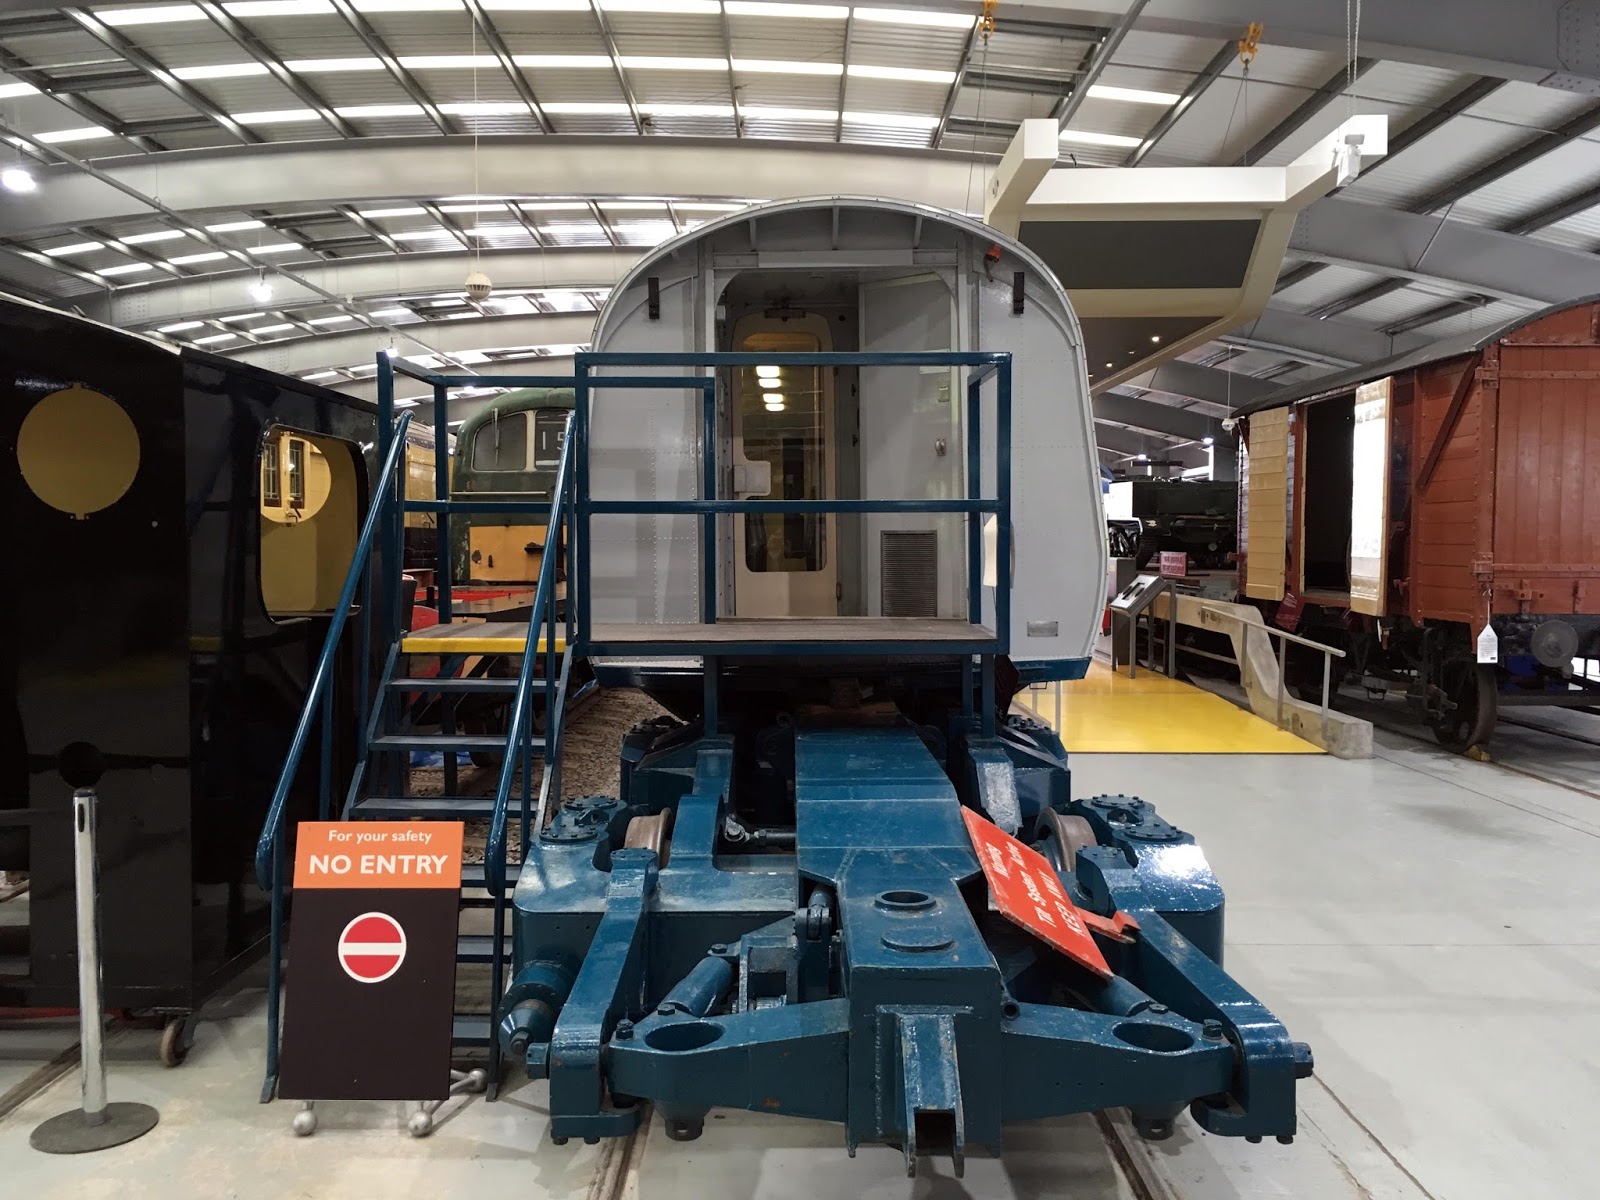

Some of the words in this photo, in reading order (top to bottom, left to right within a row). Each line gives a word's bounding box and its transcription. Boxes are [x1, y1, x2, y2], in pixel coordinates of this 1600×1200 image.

[328, 829, 353, 842] For
[356, 832, 388, 845] your
[391, 829, 433, 845] safety
[309, 854, 352, 875] NO
[360, 854, 448, 874] ENTRY
[1054, 900, 1086, 937] KEEP
